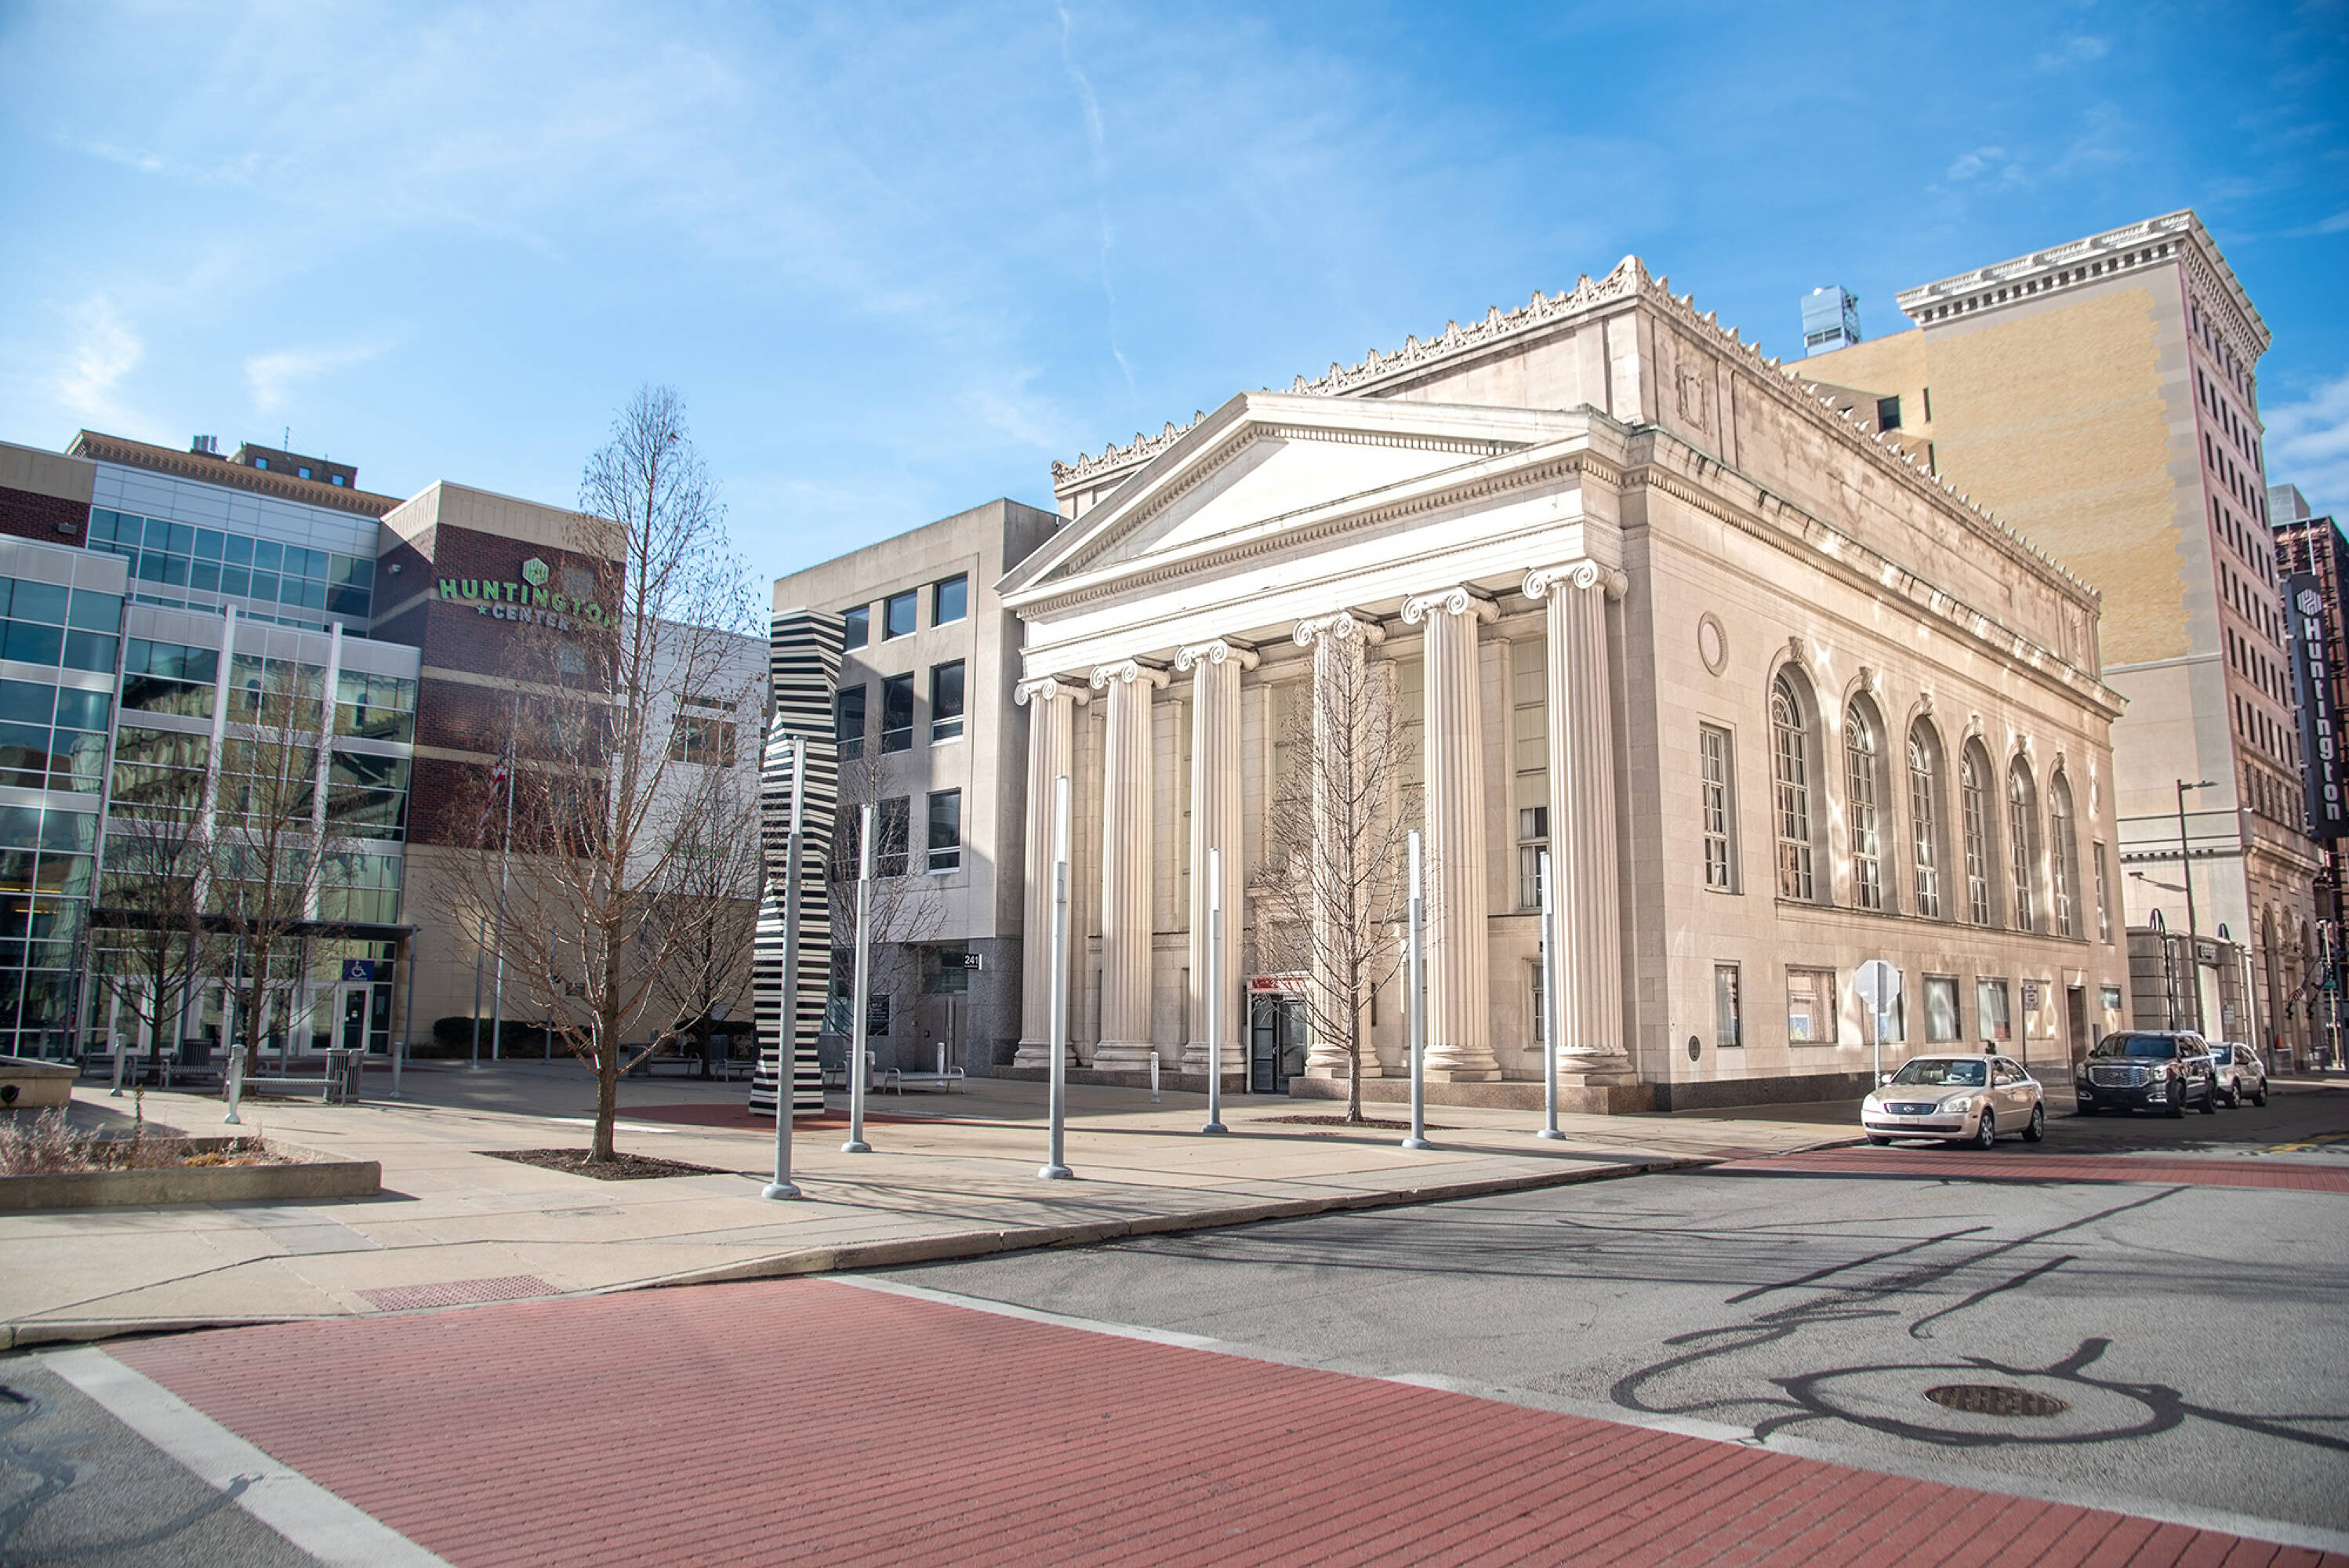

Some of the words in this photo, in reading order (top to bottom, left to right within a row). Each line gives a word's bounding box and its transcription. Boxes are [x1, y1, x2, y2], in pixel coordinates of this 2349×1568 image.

[492, 604, 569, 632] CENTER
[2304, 617, 2340, 821] Huntington
[964, 955, 978, 964] 241
